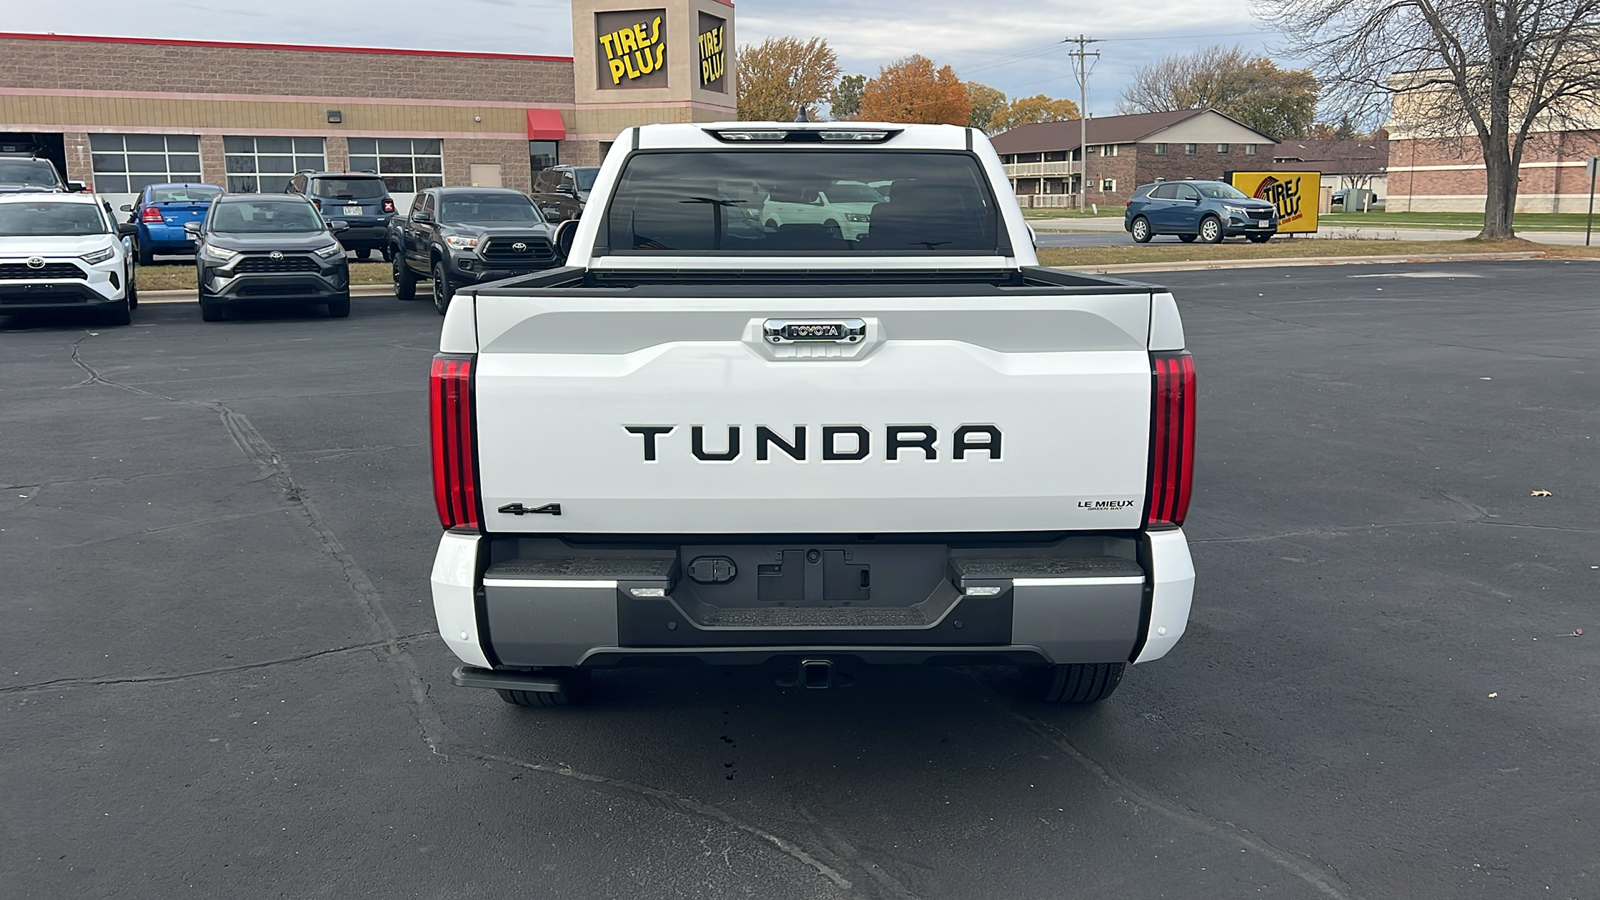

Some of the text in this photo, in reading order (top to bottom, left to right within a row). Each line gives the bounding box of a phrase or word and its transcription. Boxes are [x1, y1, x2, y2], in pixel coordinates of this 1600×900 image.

[599, 16, 662, 60] TIRES
[699, 26, 724, 59] TIRES
[608, 42, 665, 85] PLUS
[702, 52, 725, 86] PLUS
[1263, 176, 1301, 204] TIRES
[1276, 195, 1301, 219] LUS
[791, 325, 838, 336] TOYOTA
[623, 424, 1003, 462] TUNDRA
[1095, 500, 1134, 508] MIEUX
